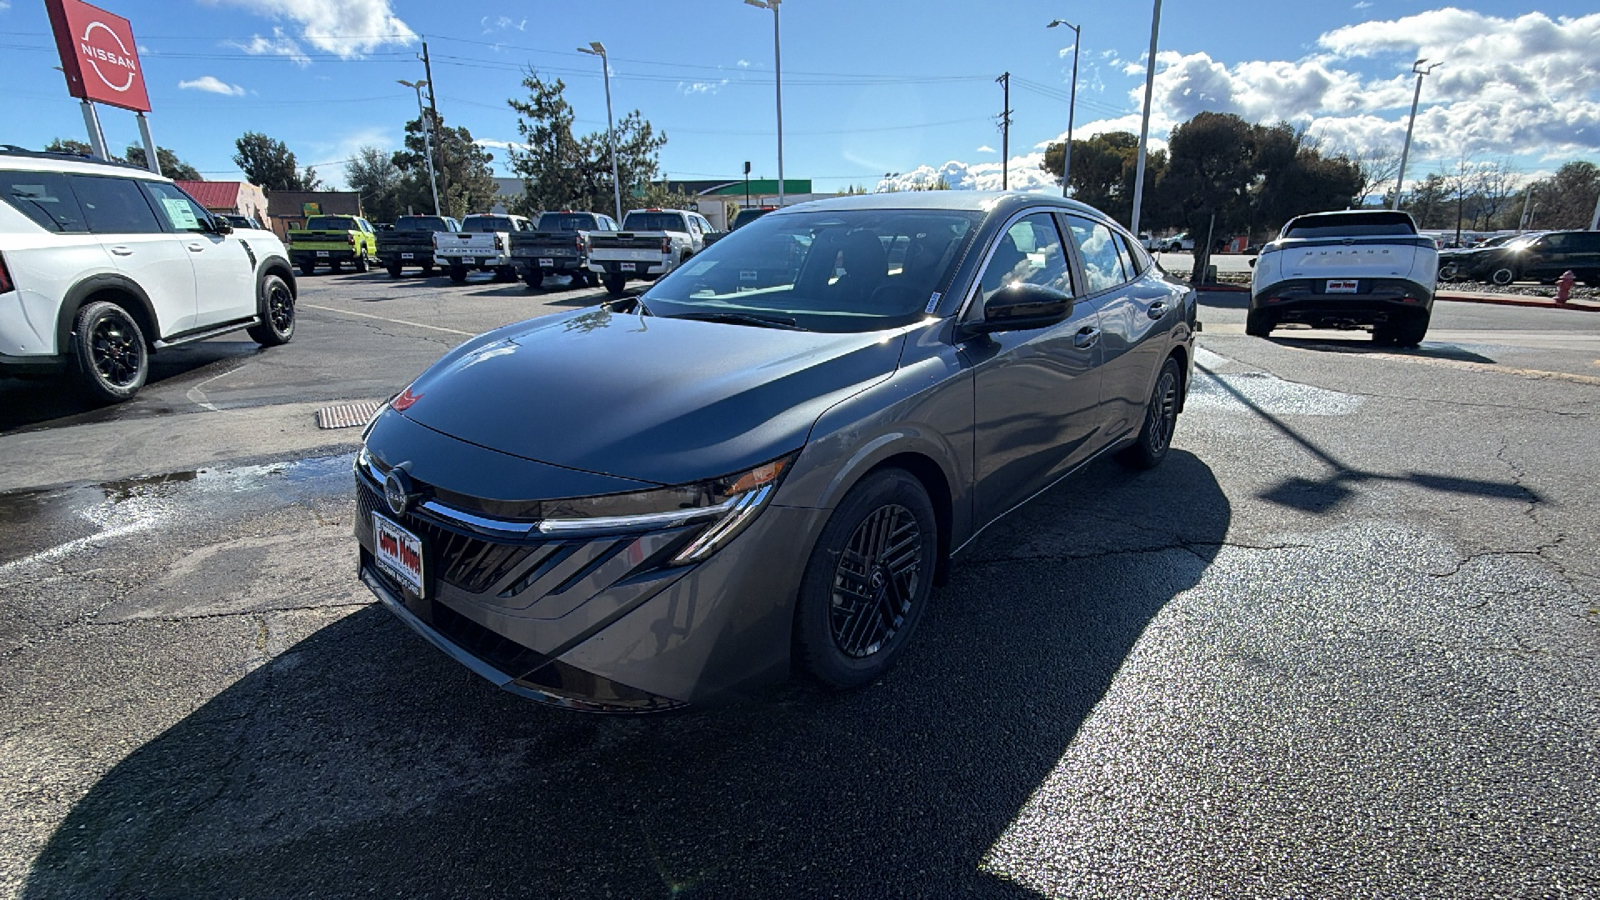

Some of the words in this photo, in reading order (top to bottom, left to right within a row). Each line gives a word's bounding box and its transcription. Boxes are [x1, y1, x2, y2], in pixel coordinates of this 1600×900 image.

[81, 42, 136, 70] NISSAN
[378, 558, 396, 578] CROWN
[396, 573, 419, 596] MOTORS
